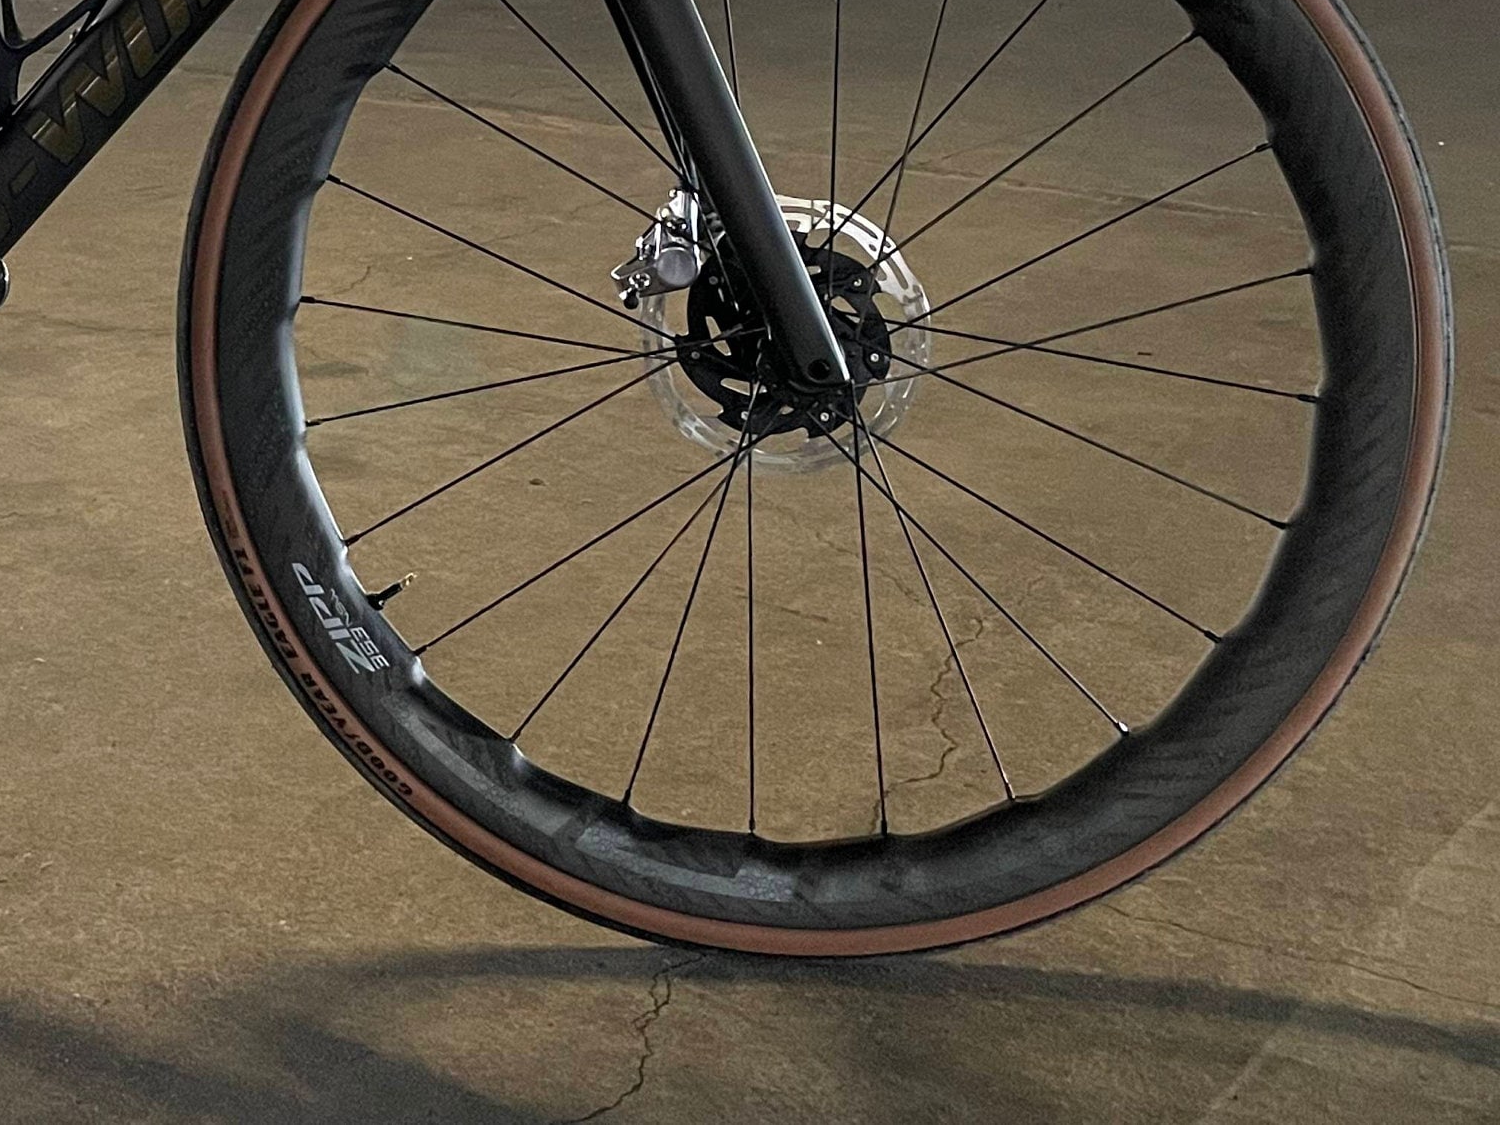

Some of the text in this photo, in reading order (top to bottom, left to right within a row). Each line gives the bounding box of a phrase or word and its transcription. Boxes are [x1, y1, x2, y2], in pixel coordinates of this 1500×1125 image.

[248, 582, 299, 659] EAGLE
[291, 562, 376, 675] ZIPP
[350, 626, 390, 671] 353
